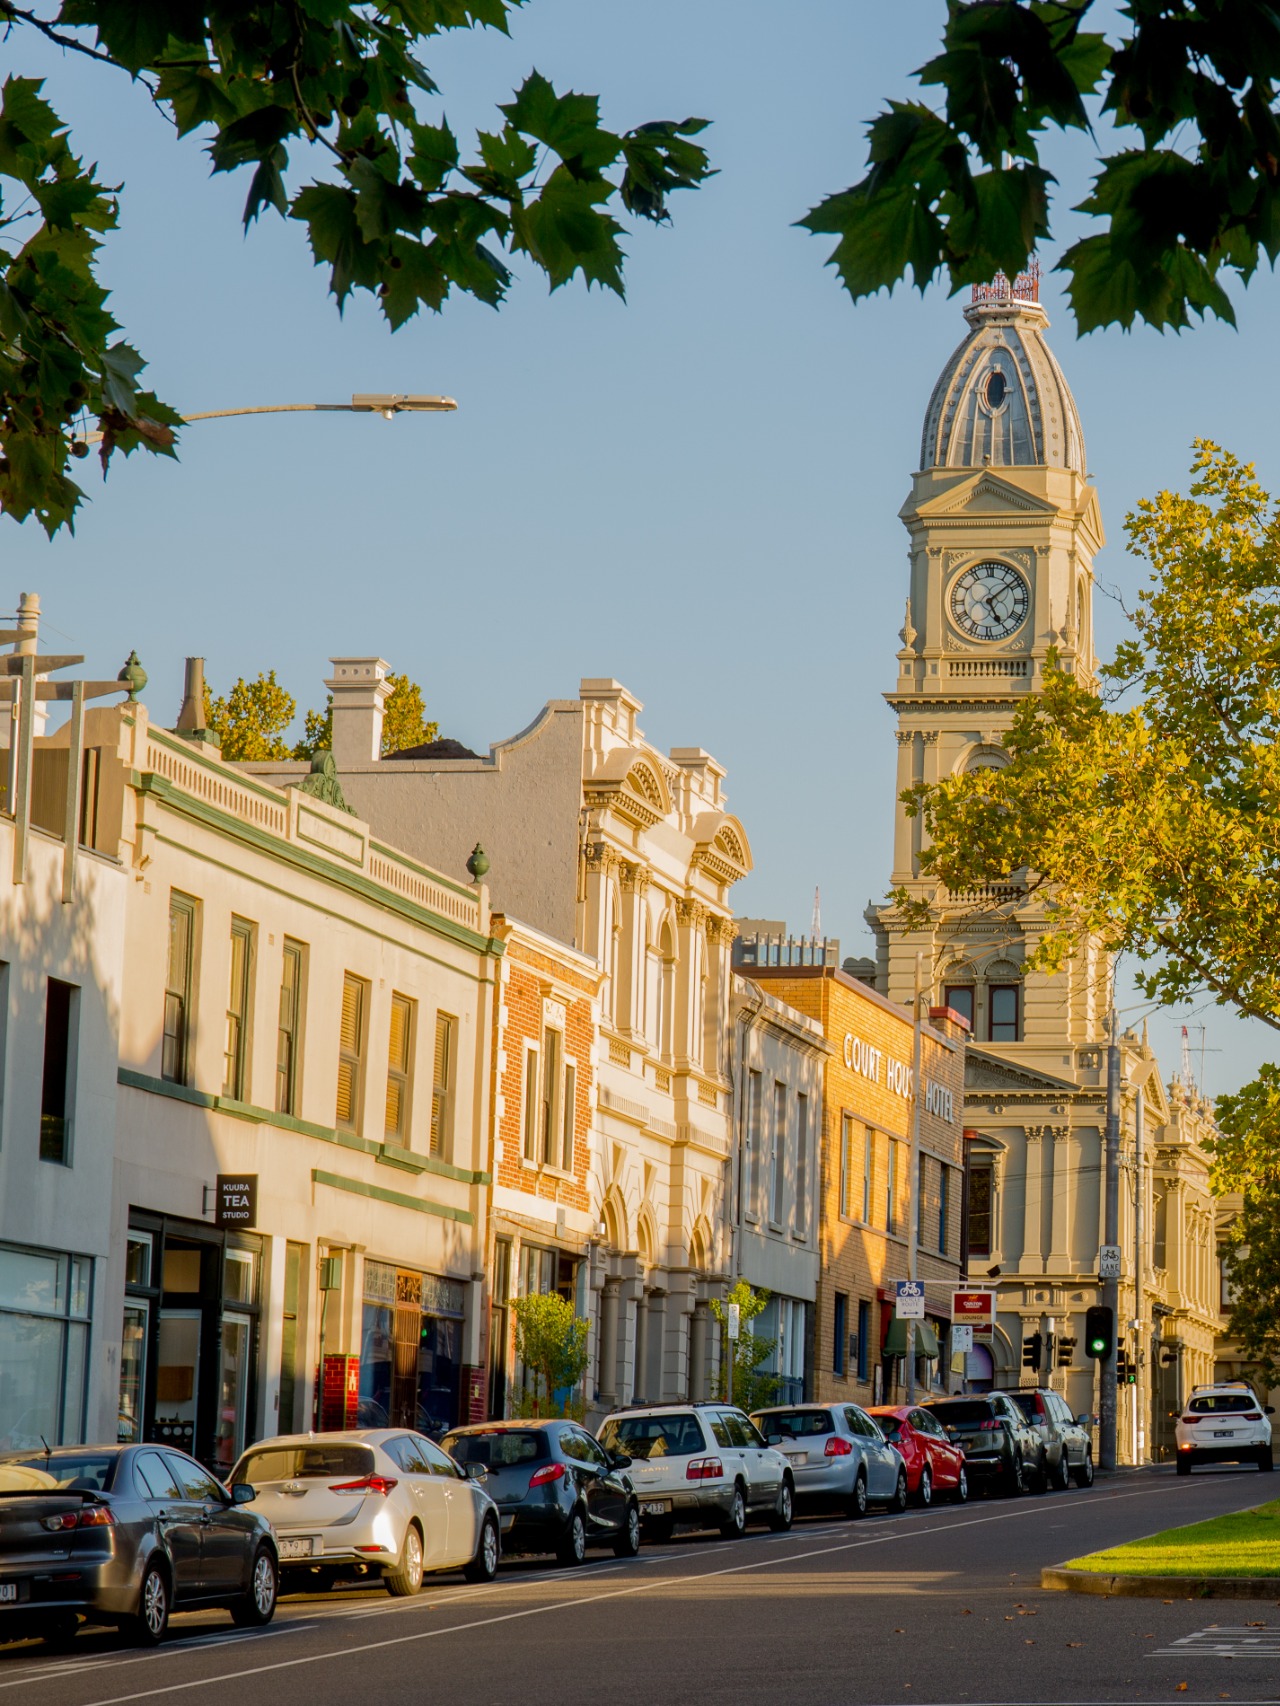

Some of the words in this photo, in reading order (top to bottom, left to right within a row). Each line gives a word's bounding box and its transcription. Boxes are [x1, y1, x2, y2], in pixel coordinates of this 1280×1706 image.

[843, 1032, 882, 1085] COURT
[886, 1055, 915, 1103] HOUS
[925, 1080, 954, 1124] HOTEL
[223, 1195, 250, 1207] TEA
[222, 1211, 250, 1219] STUDIO
[1101, 1263, 1120, 1271] LANE
